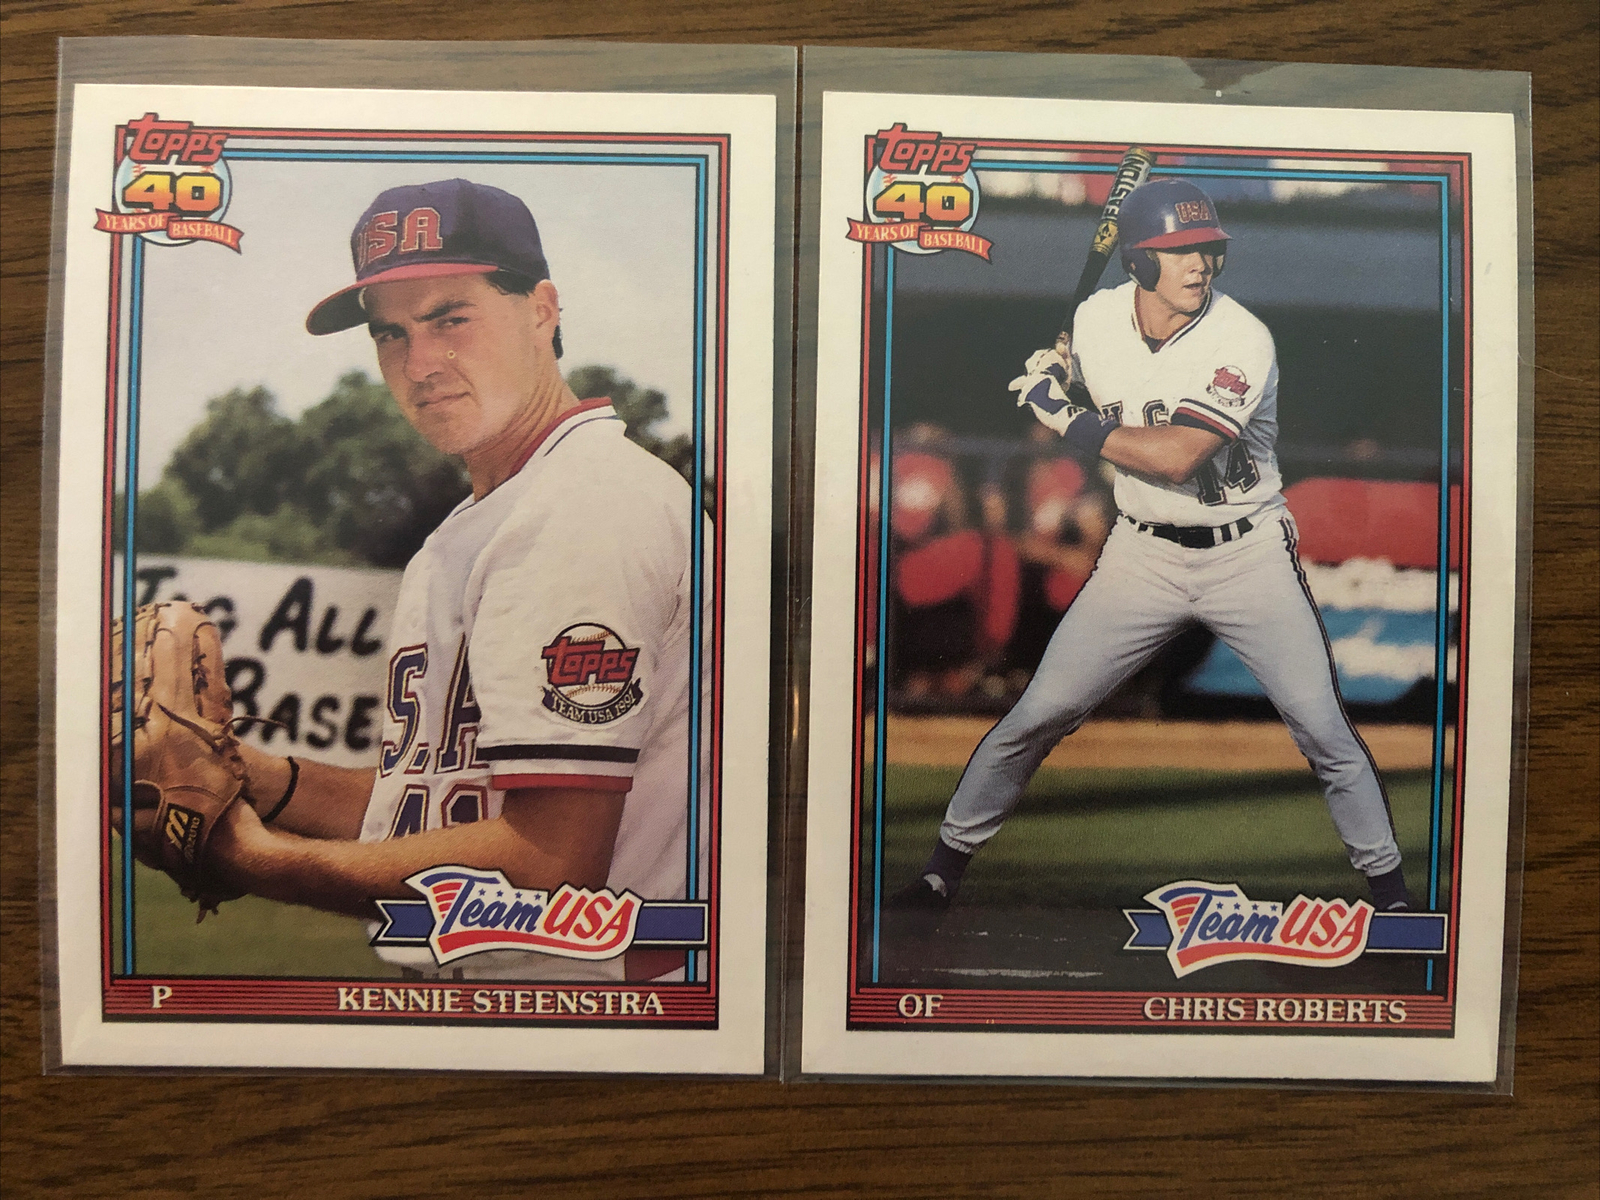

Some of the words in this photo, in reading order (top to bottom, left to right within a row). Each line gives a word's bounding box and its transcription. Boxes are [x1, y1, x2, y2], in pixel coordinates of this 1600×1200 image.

[121, 171, 224, 218] 40
[873, 181, 974, 227] 40
[1175, 200, 1213, 224] USA
[104, 214, 146, 230] YEARS
[148, 214, 165, 228] OF
[172, 222, 235, 245] BASEBALL
[855, 223, 898, 240] YEARS
[900, 223, 919, 239] OF
[923, 234, 987, 256] BASEBALL
[1197, 437, 1261, 507] 14
[259, 576, 382, 656] ALL
[551, 692, 586, 723] TEAM
[587, 708, 615, 724] USA
[615, 689, 637, 716] 1991
[419, 872, 544, 936] Team
[543, 890, 636, 944] USA
[1158, 886, 1280, 950] Team
[1279, 899, 1370, 950] USA
[151, 985, 173, 1009] P
[337, 987, 463, 1013] KENNIE
[472, 989, 665, 1016] STEENSTRA
[898, 993, 944, 1018] OF
[1143, 996, 1246, 1021] CHRIS
[1255, 998, 1408, 1023] ROBERTS
